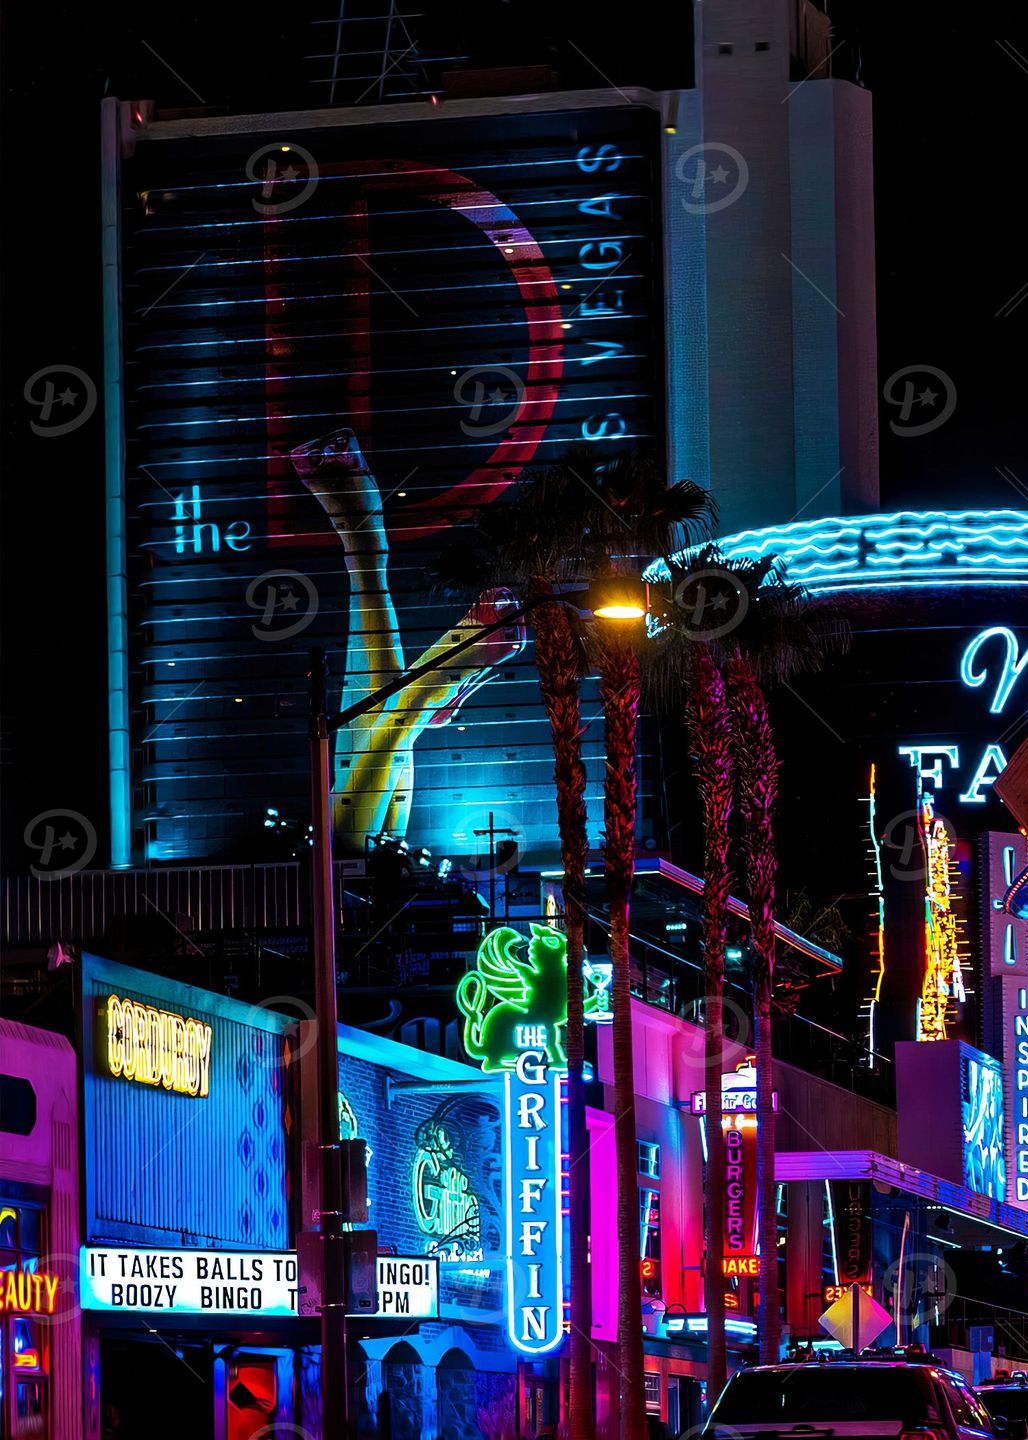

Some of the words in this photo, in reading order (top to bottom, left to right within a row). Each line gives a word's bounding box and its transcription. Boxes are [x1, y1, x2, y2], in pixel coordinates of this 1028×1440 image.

[172, 485, 252, 553] the
[107, 993, 212, 1098] CORDUROY
[516, 1025, 547, 1047] THE
[516, 1050, 550, 1342] GRIFFIN
[726, 1130, 743, 1250] BURGERS
[90, 1254, 108, 1277] IT
[118, 1254, 184, 1279] TAKES
[196, 1256, 263, 1281] BALLS
[273, 1259, 297, 1282] TO
[379, 1262, 430, 1286] INGO!
[111, 1282, 177, 1308] BOOZY
[201, 1286, 262, 1310] BINGO
